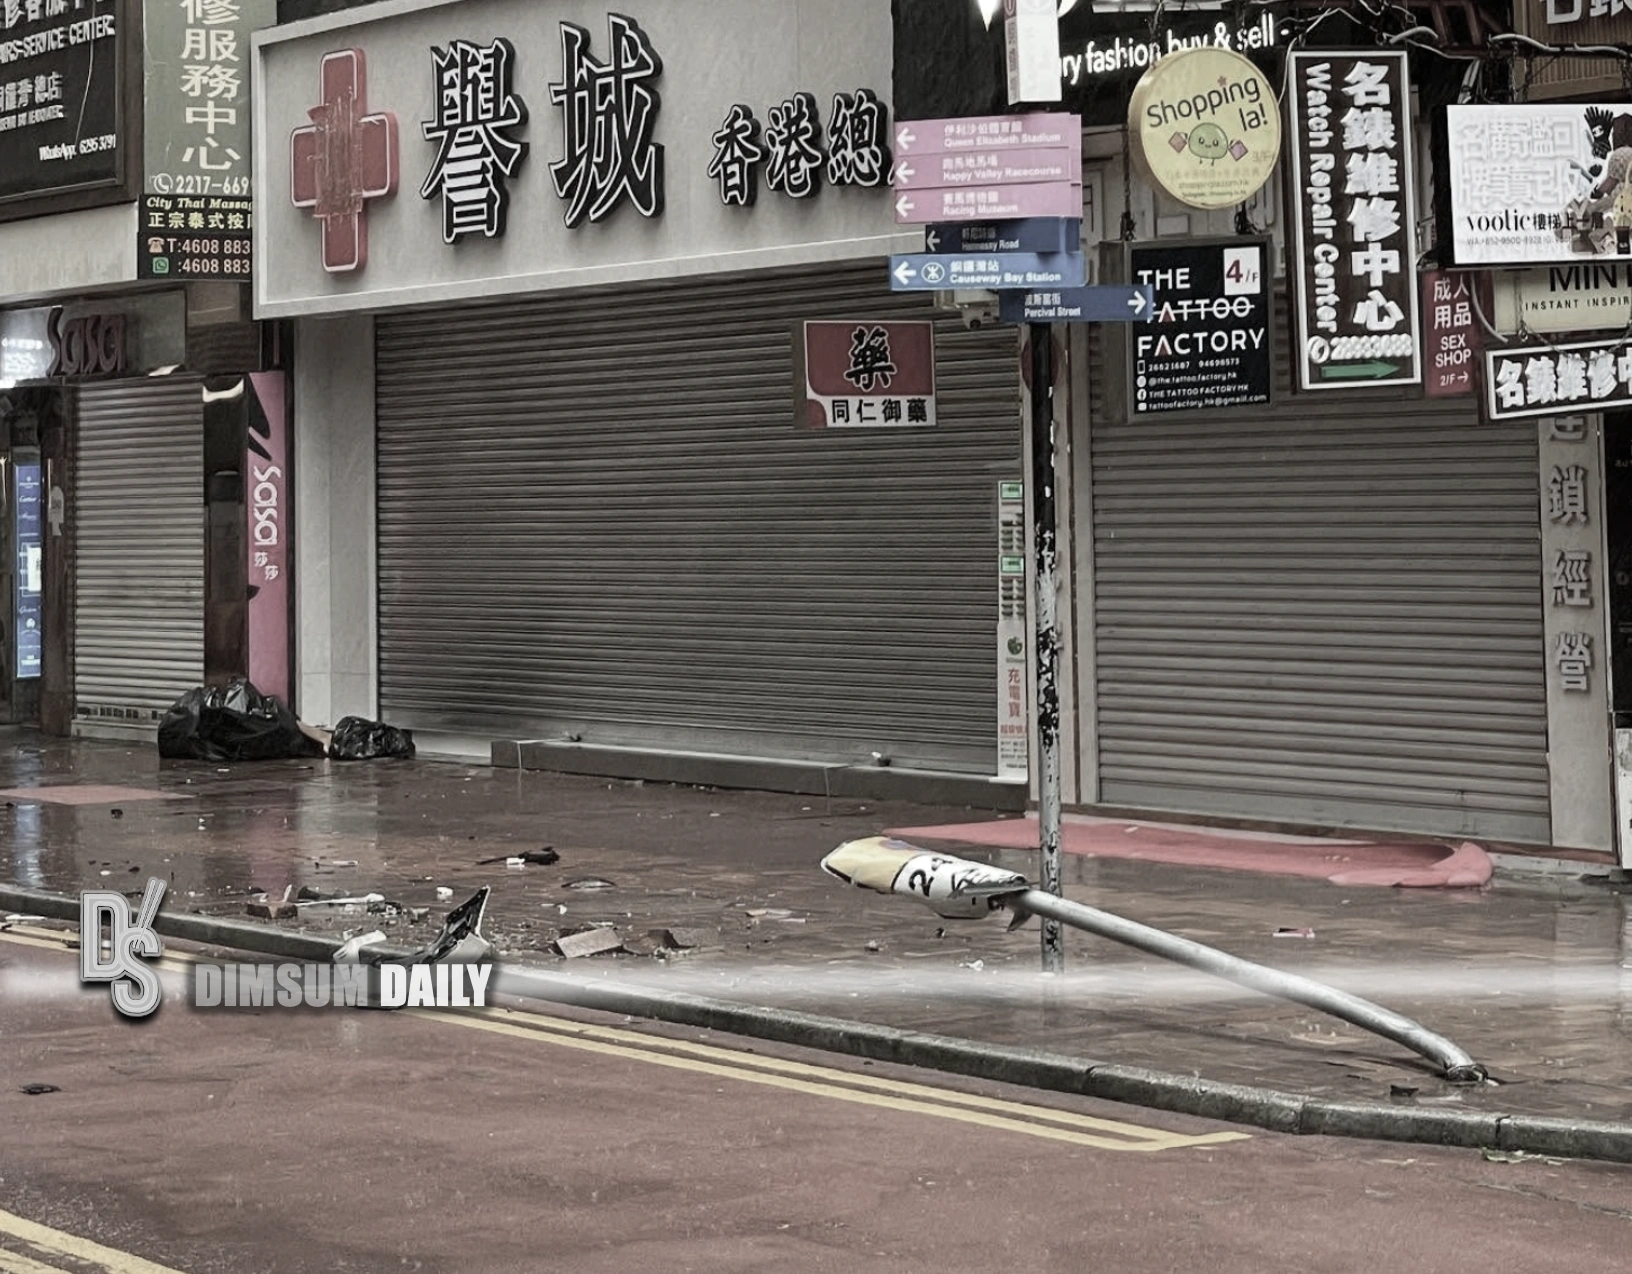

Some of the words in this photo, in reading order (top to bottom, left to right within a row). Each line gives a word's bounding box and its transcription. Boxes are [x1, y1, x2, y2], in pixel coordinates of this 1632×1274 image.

[69, 14, 116, 45] CENTER
[1085, 37, 1162, 75] fashion
[1236, 12, 1275, 50] sell
[1146, 77, 1261, 128] Shopping
[1306, 62, 1334, 148] Watch
[418, 12, 665, 244] 譽城
[1238, 103, 1269, 132] la!
[707, 88, 896, 206] 香港總
[943, 137, 975, 149] Queen
[976, 135, 1021, 147] Elizabeth
[1021, 132, 1062, 144] Stadium
[176, 173, 250, 195] 2217-669
[943, 170, 972, 182] Happy
[974, 168, 1003, 180] Valley
[1004, 166, 1063, 178] Racecourse
[146, 196, 173, 210] City
[177, 197, 206, 210] Thai
[1306, 153, 1337, 241] Repair
[1340, 61, 1405, 332] 名錶維修中心
[147, 211, 253, 230] 正宗泰式按
[943, 205, 976, 217] Racing
[978, 203, 1019, 214] Museum
[999, 238, 1020, 250] Road
[949, 272, 1001, 285] Causeway
[1003, 272, 1024, 284] Bay
[1026, 270, 1062, 282] Station
[1137, 267, 1191, 291] THE
[1313, 242, 1341, 335] Center
[1433, 274, 1470, 303] 成人
[1024, 306, 1056, 318] Percival
[1057, 306, 1081, 317] Street
[1147, 297, 1252, 324] ATTOO
[1433, 302, 1472, 330] 用品
[1525, 299, 1579, 311] INSTANT
[1137, 327, 1265, 358] FACTORY
[1441, 333, 1466, 350] SEX
[1435, 348, 1472, 368] SHOP
[1149, 390, 1165, 398] THE
[1166, 387, 1199, 397] TATTOO
[1200, 385, 1237, 394] FACTORY
[1440, 373, 1456, 386] 2/F
[831, 398, 928, 423] 同仁御藥
